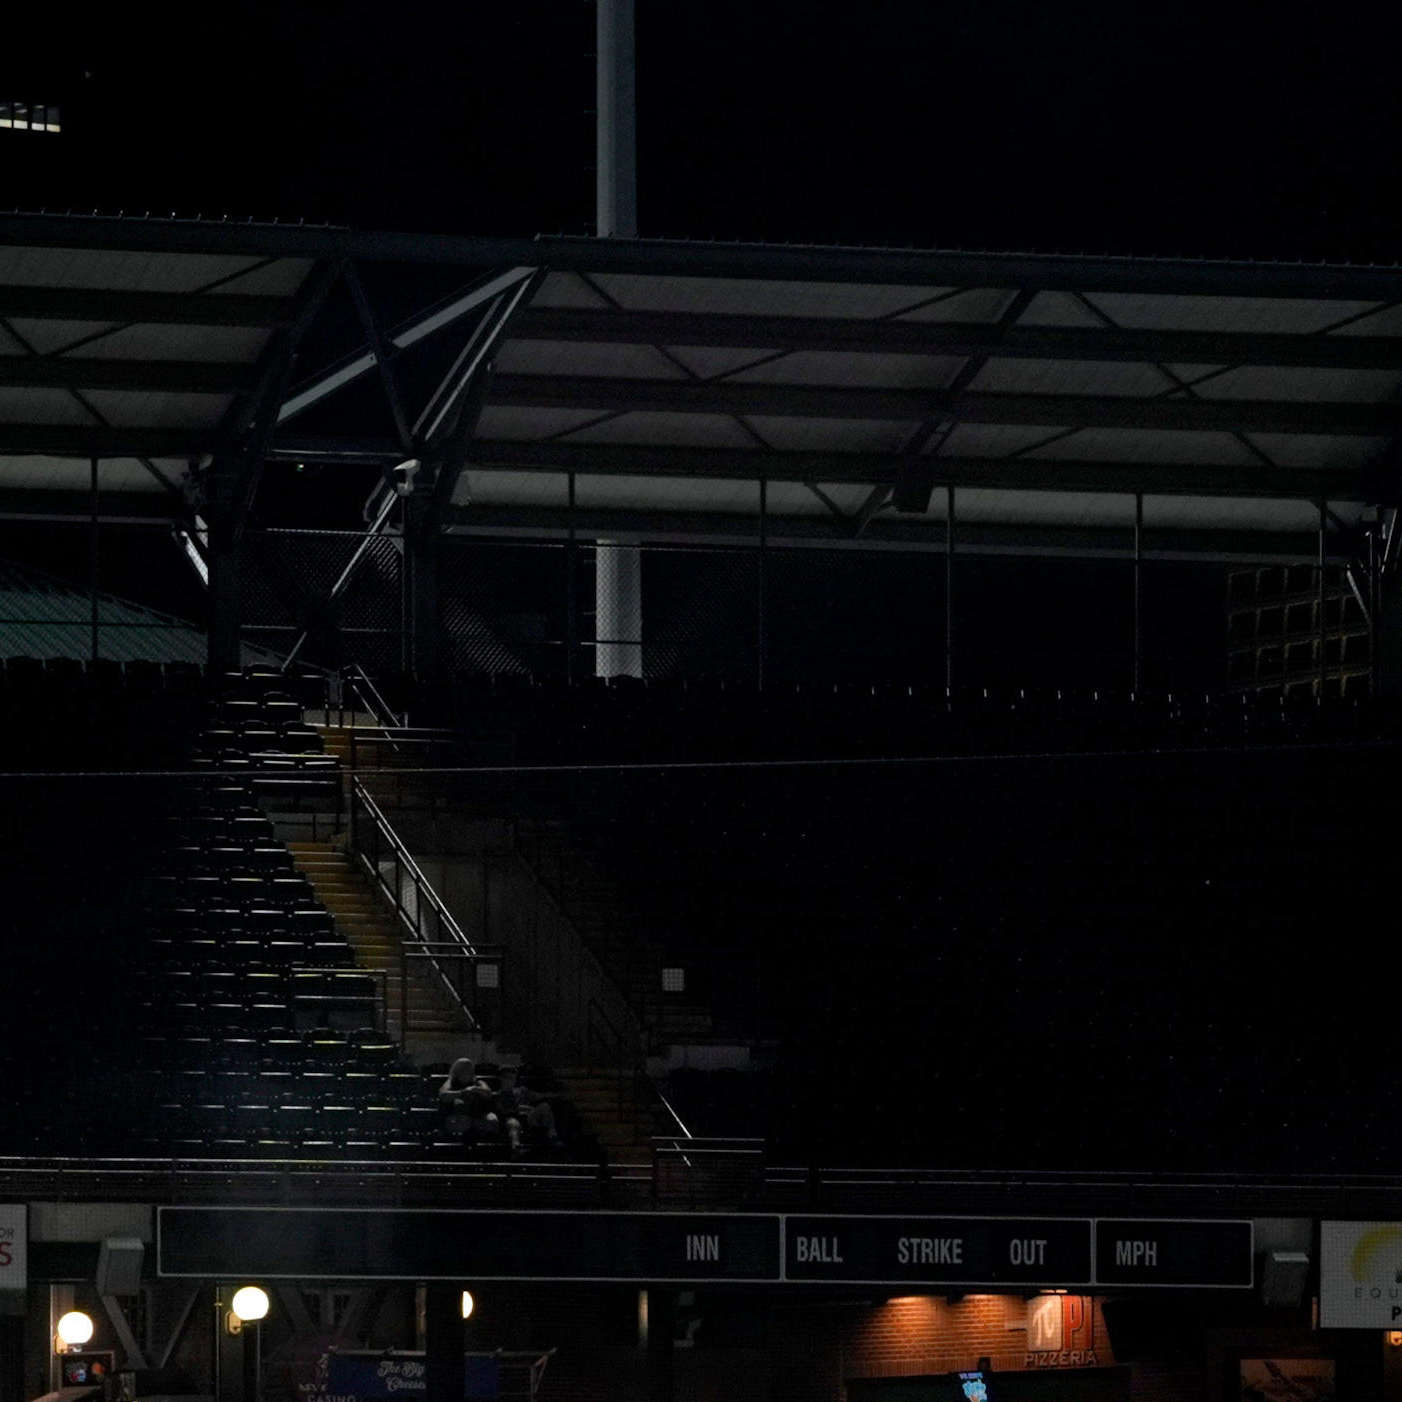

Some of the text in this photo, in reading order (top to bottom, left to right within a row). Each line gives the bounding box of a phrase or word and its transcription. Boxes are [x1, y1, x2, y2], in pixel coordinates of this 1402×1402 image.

[686, 1234, 719, 1262] INN
[796, 1235, 1048, 1266] BALL STRIKE OUT
[1115, 1240, 1158, 1267] MPH
[1062, 1295, 1094, 1350] PI
[1023, 1350, 1098, 1368] PIZZERIA
